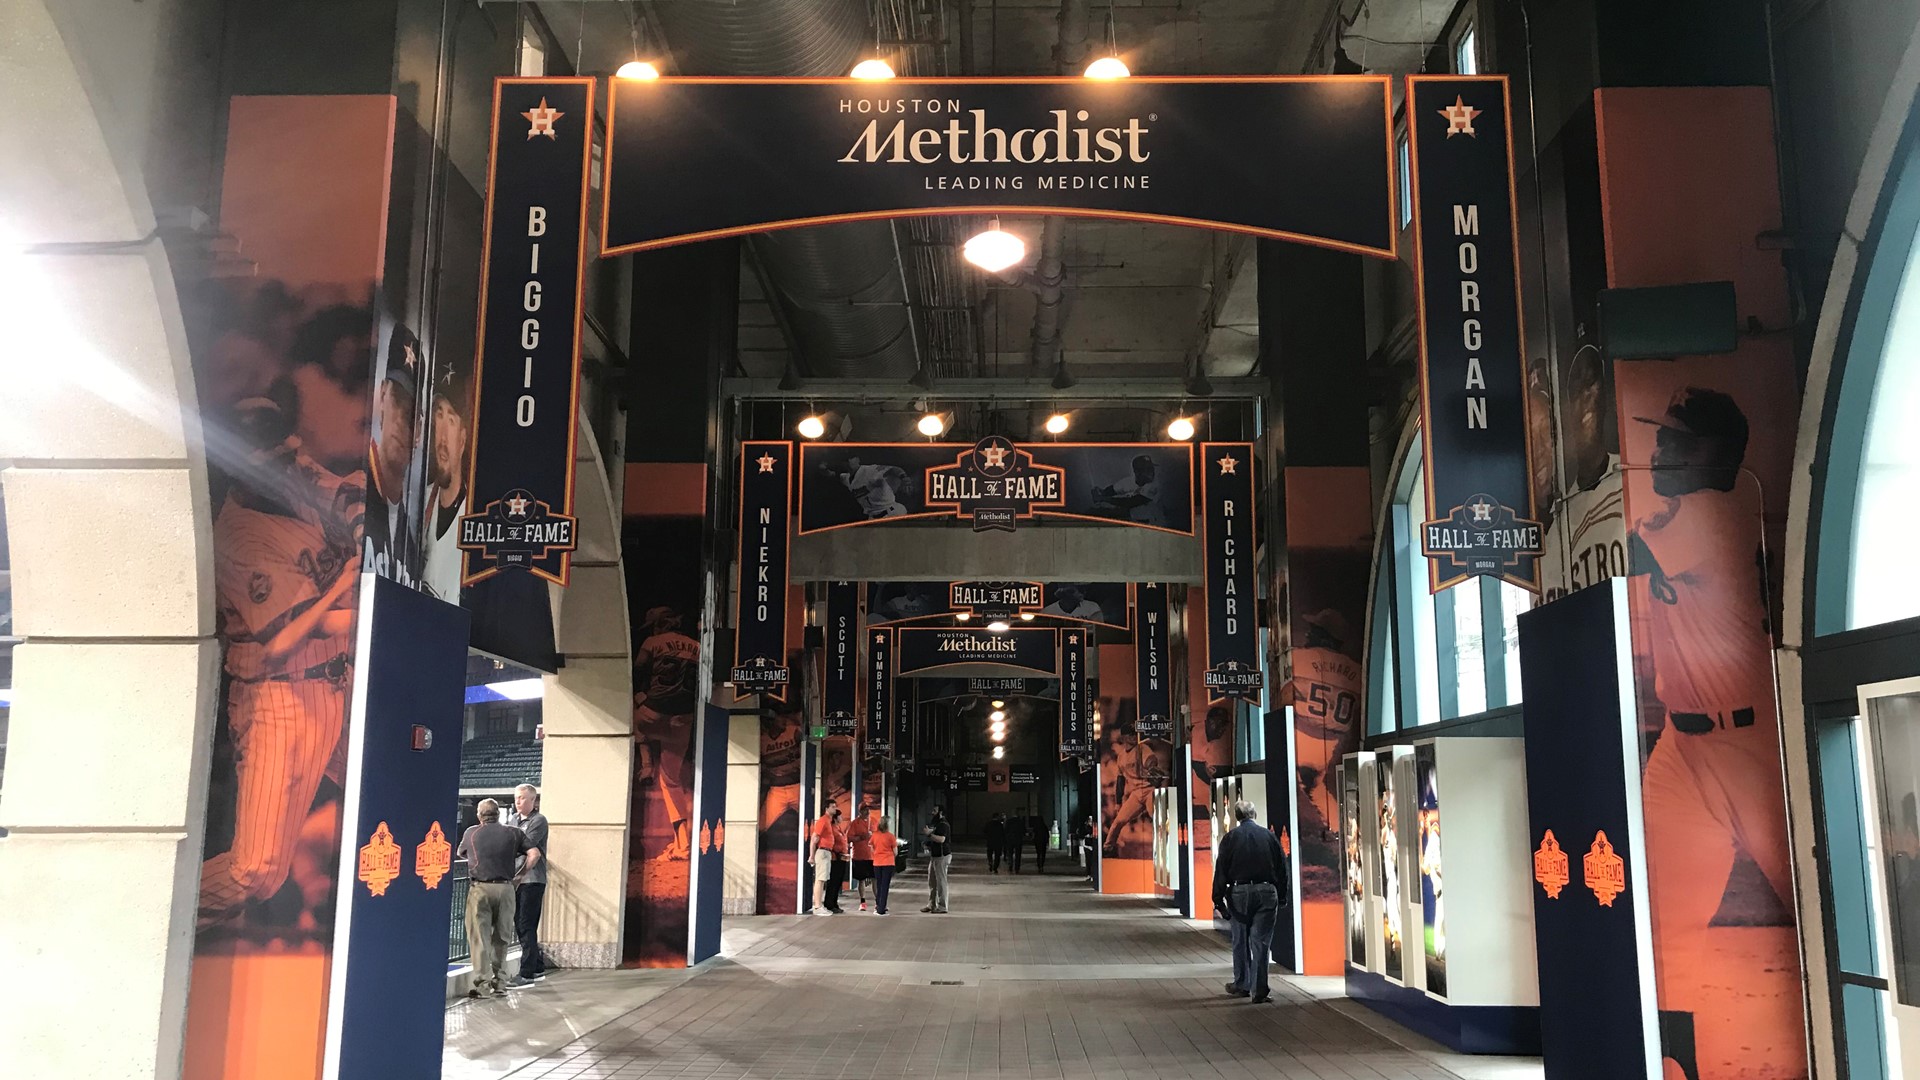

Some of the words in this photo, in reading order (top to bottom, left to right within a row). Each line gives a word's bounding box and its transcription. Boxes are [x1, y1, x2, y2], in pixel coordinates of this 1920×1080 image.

[840, 99, 960, 113] HOUSTON
[925, 176, 1023, 190] LEADING
[1038, 175, 1150, 190] MEDICINE
[516, 206, 547, 427] BIGGIO
[1453, 204, 1488, 430] MORGAN
[932, 473, 982, 499] HALL
[985, 480, 999, 496] of
[1004, 473, 1058, 499] FAME
[979, 512, 1012, 521] Methodist
[463, 520, 505, 543] HALL
[507, 527, 520, 540] of
[524, 521, 570, 543] FAME
[1428, 526, 1473, 549] HALL
[1476, 533, 1488, 546] of
[1492, 526, 1540, 549] FAME
[757, 508, 770, 622] NIEKRO
[1224, 500, 1238, 635] RICHARD
[1475, 561, 1496, 569] MORGAN
[954, 586, 987, 604] HALL
[1003, 586, 1039, 604] FAME
[838, 616, 846, 681] SCOTT
[937, 636, 1017, 652] Methodist
[1147, 612, 1158, 690] WILSON
[734, 669, 755, 681] HALL
[764, 669, 787, 681] FAME
[971, 678, 992, 689] HALL
[1000, 678, 1023, 689] FAME
[1206, 673, 1228, 684] HALL
[1237, 673, 1261, 685] FAME
[875, 651, 883, 730] UMBRICHT
[1308, 682, 1356, 725] 50
[842, 719, 858, 727] FAME
[1137, 722, 1152, 730] HALL
[1158, 722, 1173, 730] FAME
[1586, 860, 1600, 879] HALL
[1606, 862, 1622, 882] FAME
